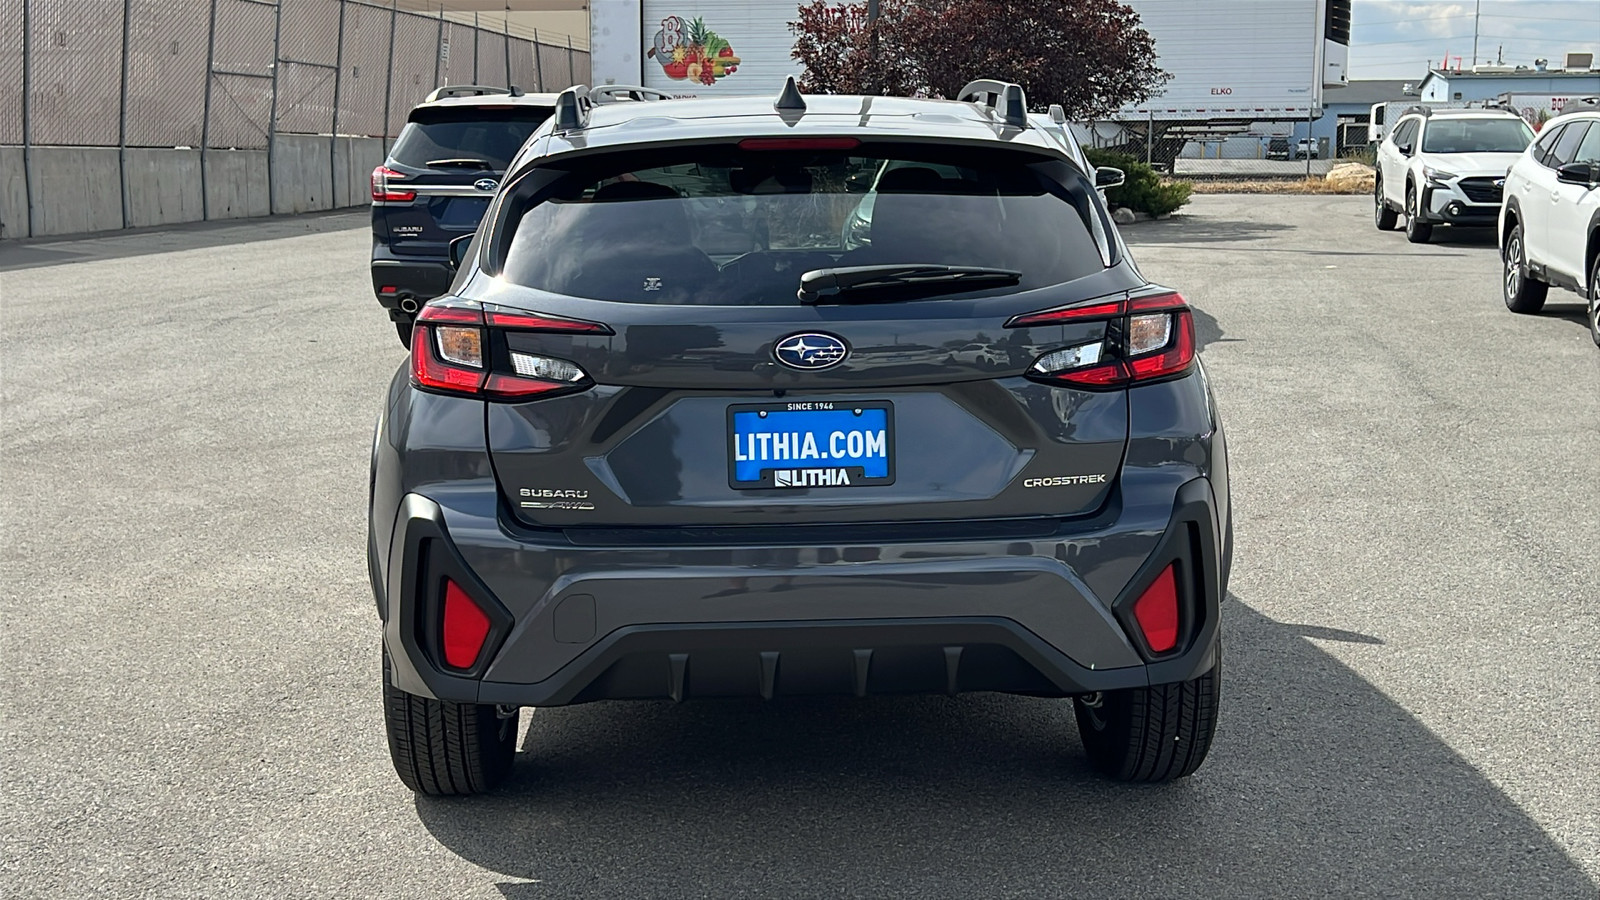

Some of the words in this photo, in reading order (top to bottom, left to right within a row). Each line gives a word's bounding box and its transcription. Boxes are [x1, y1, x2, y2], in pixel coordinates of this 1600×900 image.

[787, 403, 812, 411] SINCE
[814, 402, 834, 410] 1946
[734, 429, 886, 461] LITHIA.COM
[792, 468, 850, 486] LITHIA
[1023, 474, 1106, 488] CROSSTREK
[519, 488, 589, 499] SUBARU
